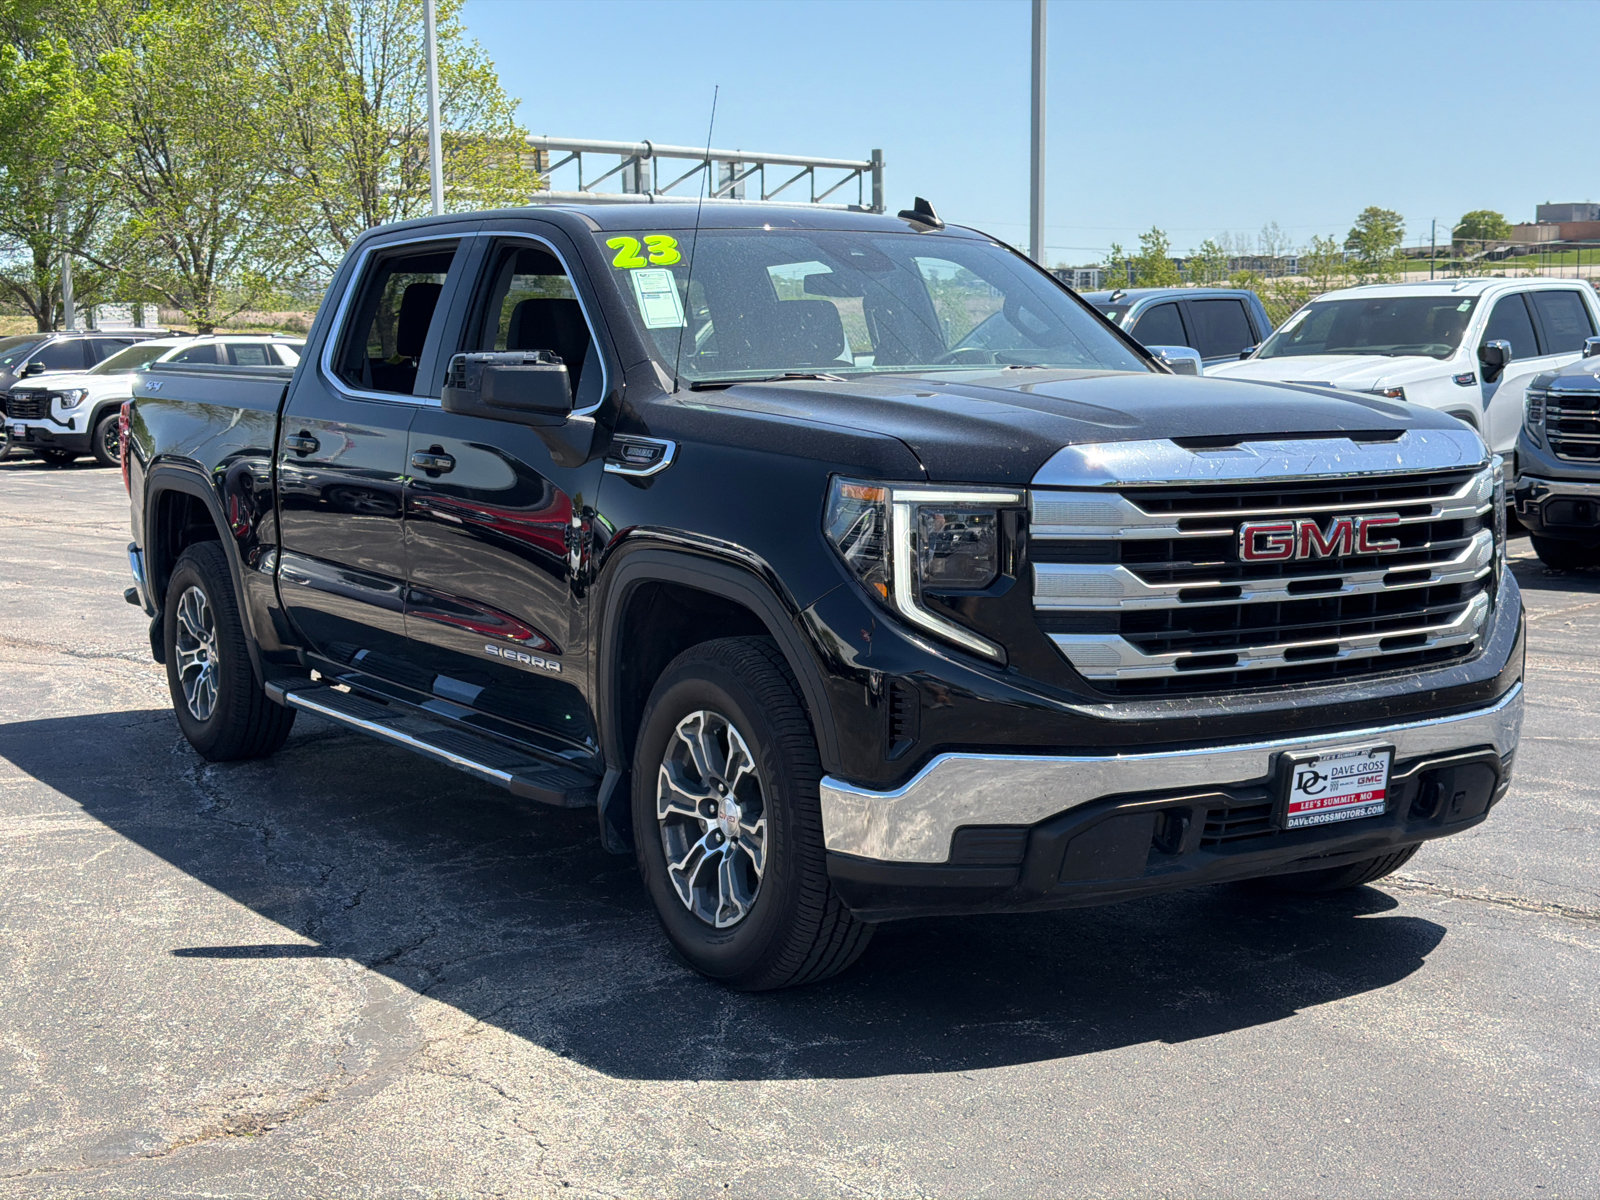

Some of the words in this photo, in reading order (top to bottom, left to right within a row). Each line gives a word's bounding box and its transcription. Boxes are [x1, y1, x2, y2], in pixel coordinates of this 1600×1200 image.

[605, 234, 682, 269] 23
[1239, 511, 1401, 563] GMC
[484, 643, 562, 674] SIERRA
[1331, 764, 1355, 777] DAVE
[1356, 760, 1385, 773] CROSS
[1357, 774, 1383, 785] GMC
[1300, 799, 1322, 810] LEE'S
[1359, 792, 1373, 801] MO
[1287, 804, 1385, 828] DAVECROSSMOTORS.COM
